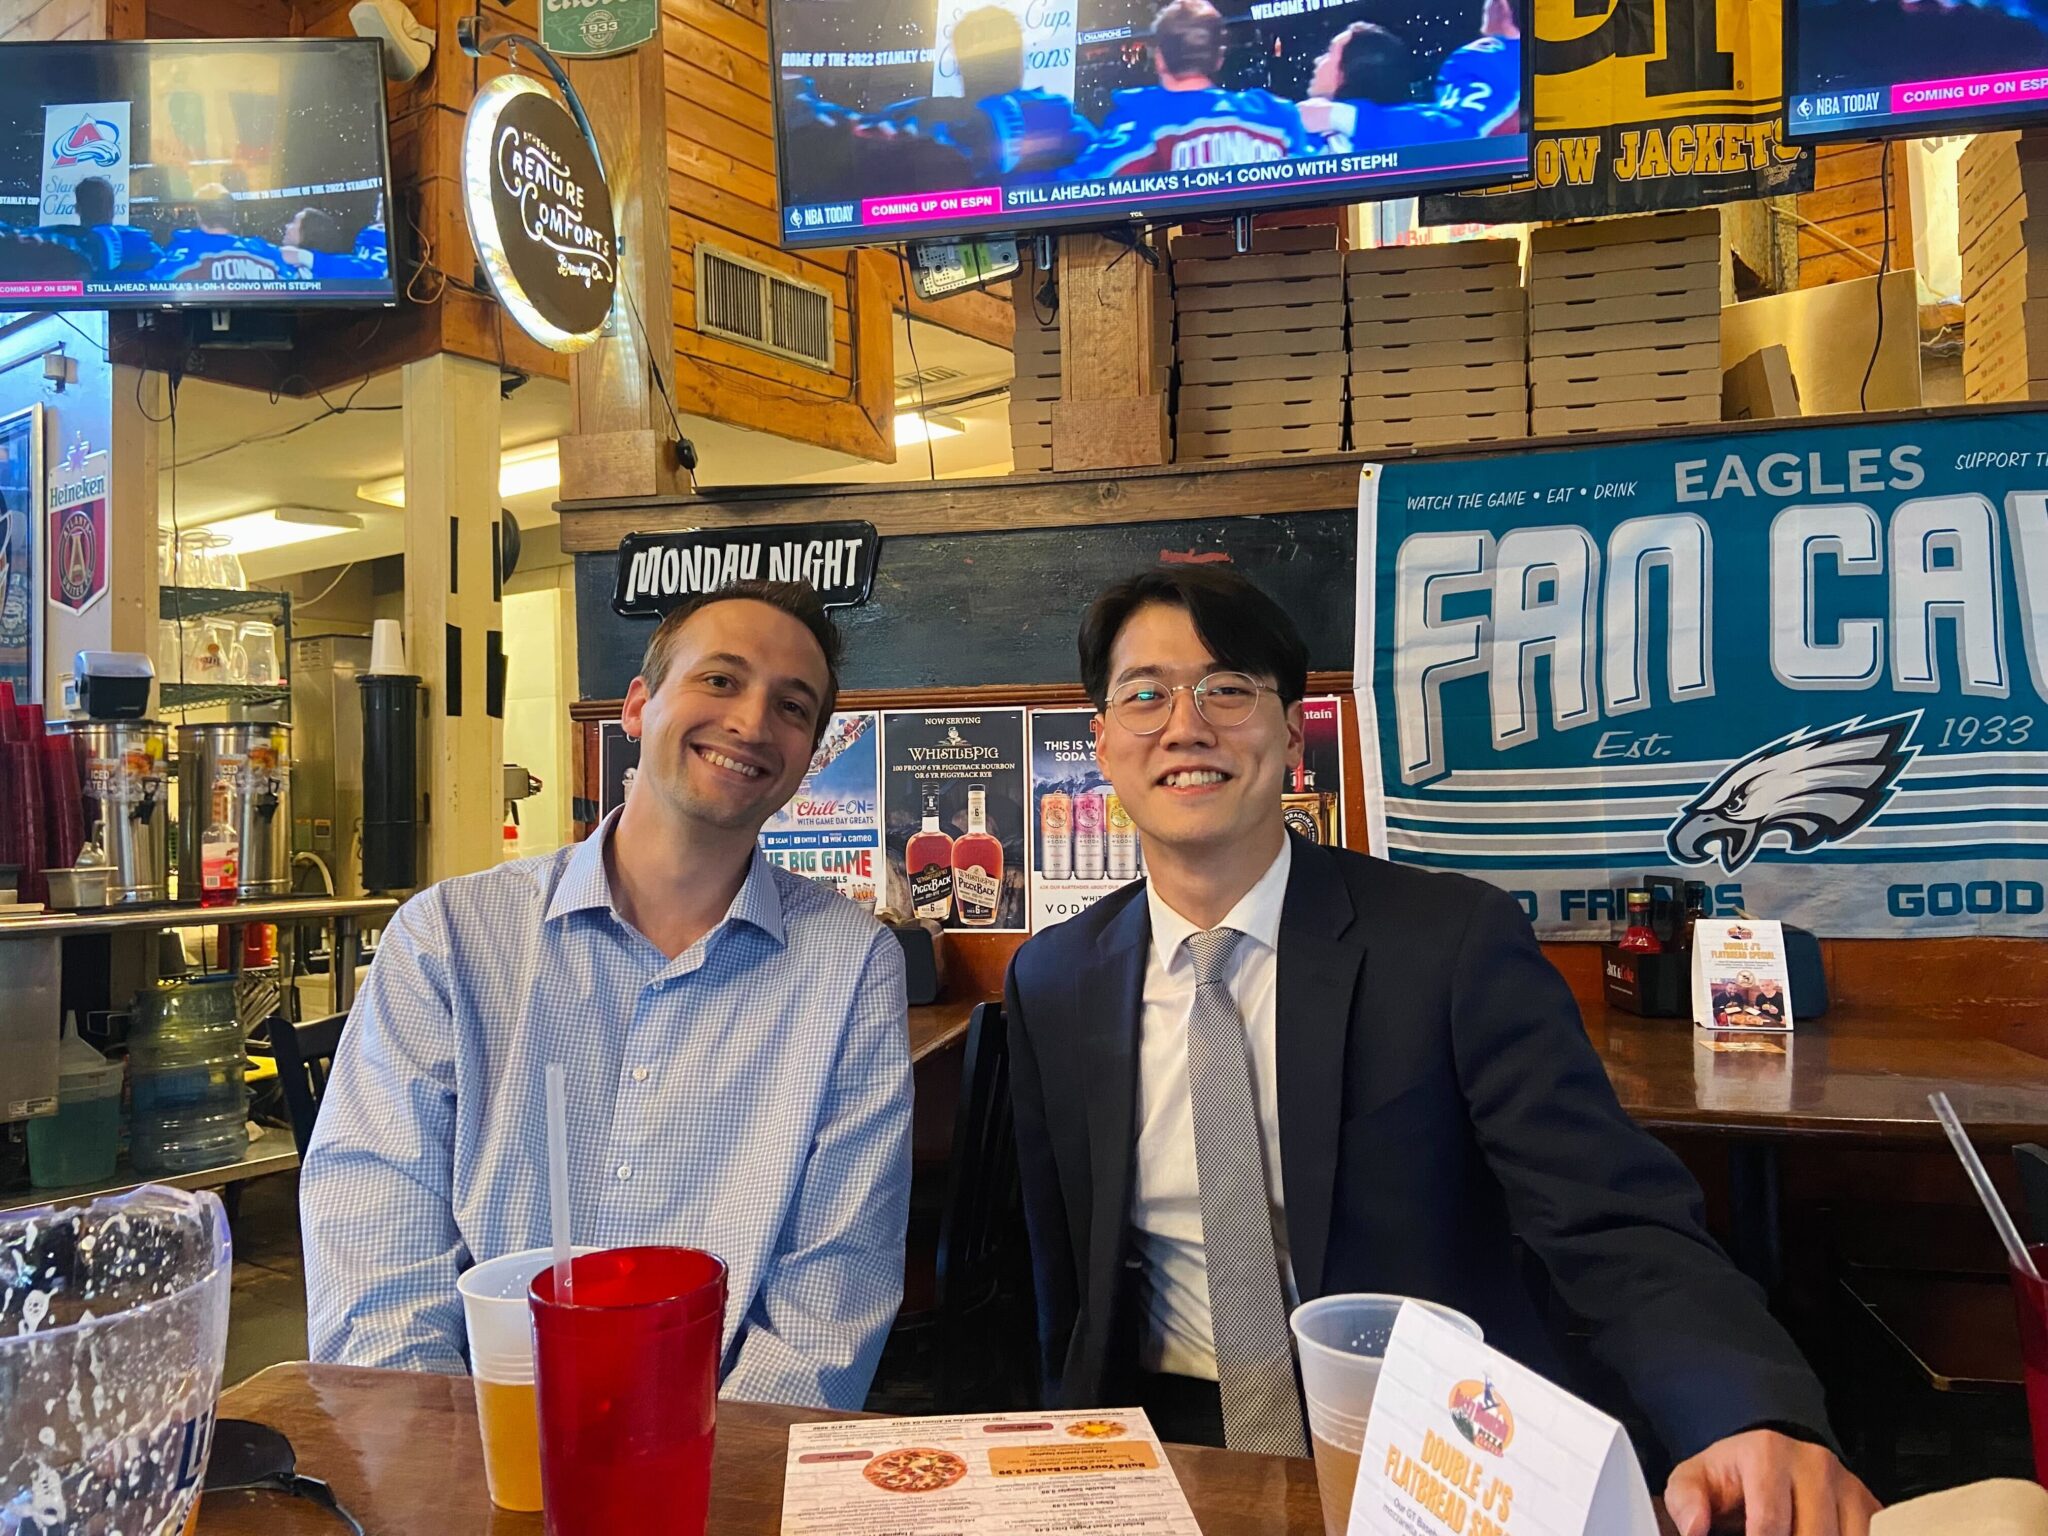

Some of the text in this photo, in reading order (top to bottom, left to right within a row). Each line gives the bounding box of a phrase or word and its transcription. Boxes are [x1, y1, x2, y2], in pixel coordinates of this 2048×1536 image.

[1251, 0, 1304, 20] WELCOME
[580, 21, 618, 34] 1933
[781, 53, 812, 67] HOME
[813, 52, 826, 66] OF
[828, 52, 846, 66] THE
[847, 52, 874, 66] 2022
[876, 50, 917, 65] STANLEY
[1441, 83, 1492, 111] 42
[1903, 77, 2048, 103] COMING UP ON ESP
[1816, 92, 1879, 115] NBA TODAY
[1613, 118, 1802, 182] JACKETS
[498, 126, 585, 209] CREATURE
[325, 183, 345, 193] 2022
[1007, 152, 1398, 205] STILL AHEAD: MALIKA'S 1-ON-1 CONVO WITH STEPH!
[805, 205, 853, 226] NBA TODAY
[871, 196, 992, 216] COMING UP ON ESPN
[520, 182, 610, 258] COMFORTS
[359, 246, 387, 261] 42
[558, 254, 591, 288] Brewing
[114, 284, 148, 292] AHEAD:
[228, 282, 260, 290] CONVO
[263, 282, 286, 290] WITH
[288, 282, 321, 290] STEPH!
[1954, 452, 2032, 470] SUPPORT
[1674, 445, 1925, 503] EAGLES
[50, 475, 105, 508] Heineken
[1407, 481, 1638, 511] WATCH THE GAME EAT DRINK
[63, 515, 92, 538] ATLANTA
[625, 538, 863, 604] MONDAY NIGHT
[63, 576, 83, 597] UNITED
[1395, 511, 1715, 787] FAN
[946, 717, 981, 725] SERVING
[1044, 741, 1069, 750] THIS
[1072, 741, 1083, 750] IS
[1593, 716, 2034, 760] Est. 1933
[908, 746, 999, 761] WHISTLEPIG
[1055, 752, 1087, 761] SODA
[90, 770, 110, 779] ICED
[92, 781, 108, 791] TEA
[796, 800, 838, 816] Chill
[974, 808, 979, 816] 6
[816, 817, 834, 825] GAME
[835, 817, 848, 825] DAY
[789, 851, 817, 872] BIG
[821, 850, 871, 877] GAME
[912, 875, 952, 896] PIGGYBACK
[958, 876, 995, 896] PIGGYBACK
[930, 904, 935, 912] 6
[1887, 880, 2044, 917] GOOD
[975, 905, 980, 914] 6
[1421, 1428, 1483, 1501] DOUBLE
[1482, 1477, 1513, 1522] J'S
[1384, 1443, 1467, 1534] FLATBREAD
[1393, 1498, 1417, 1521] Our GT
